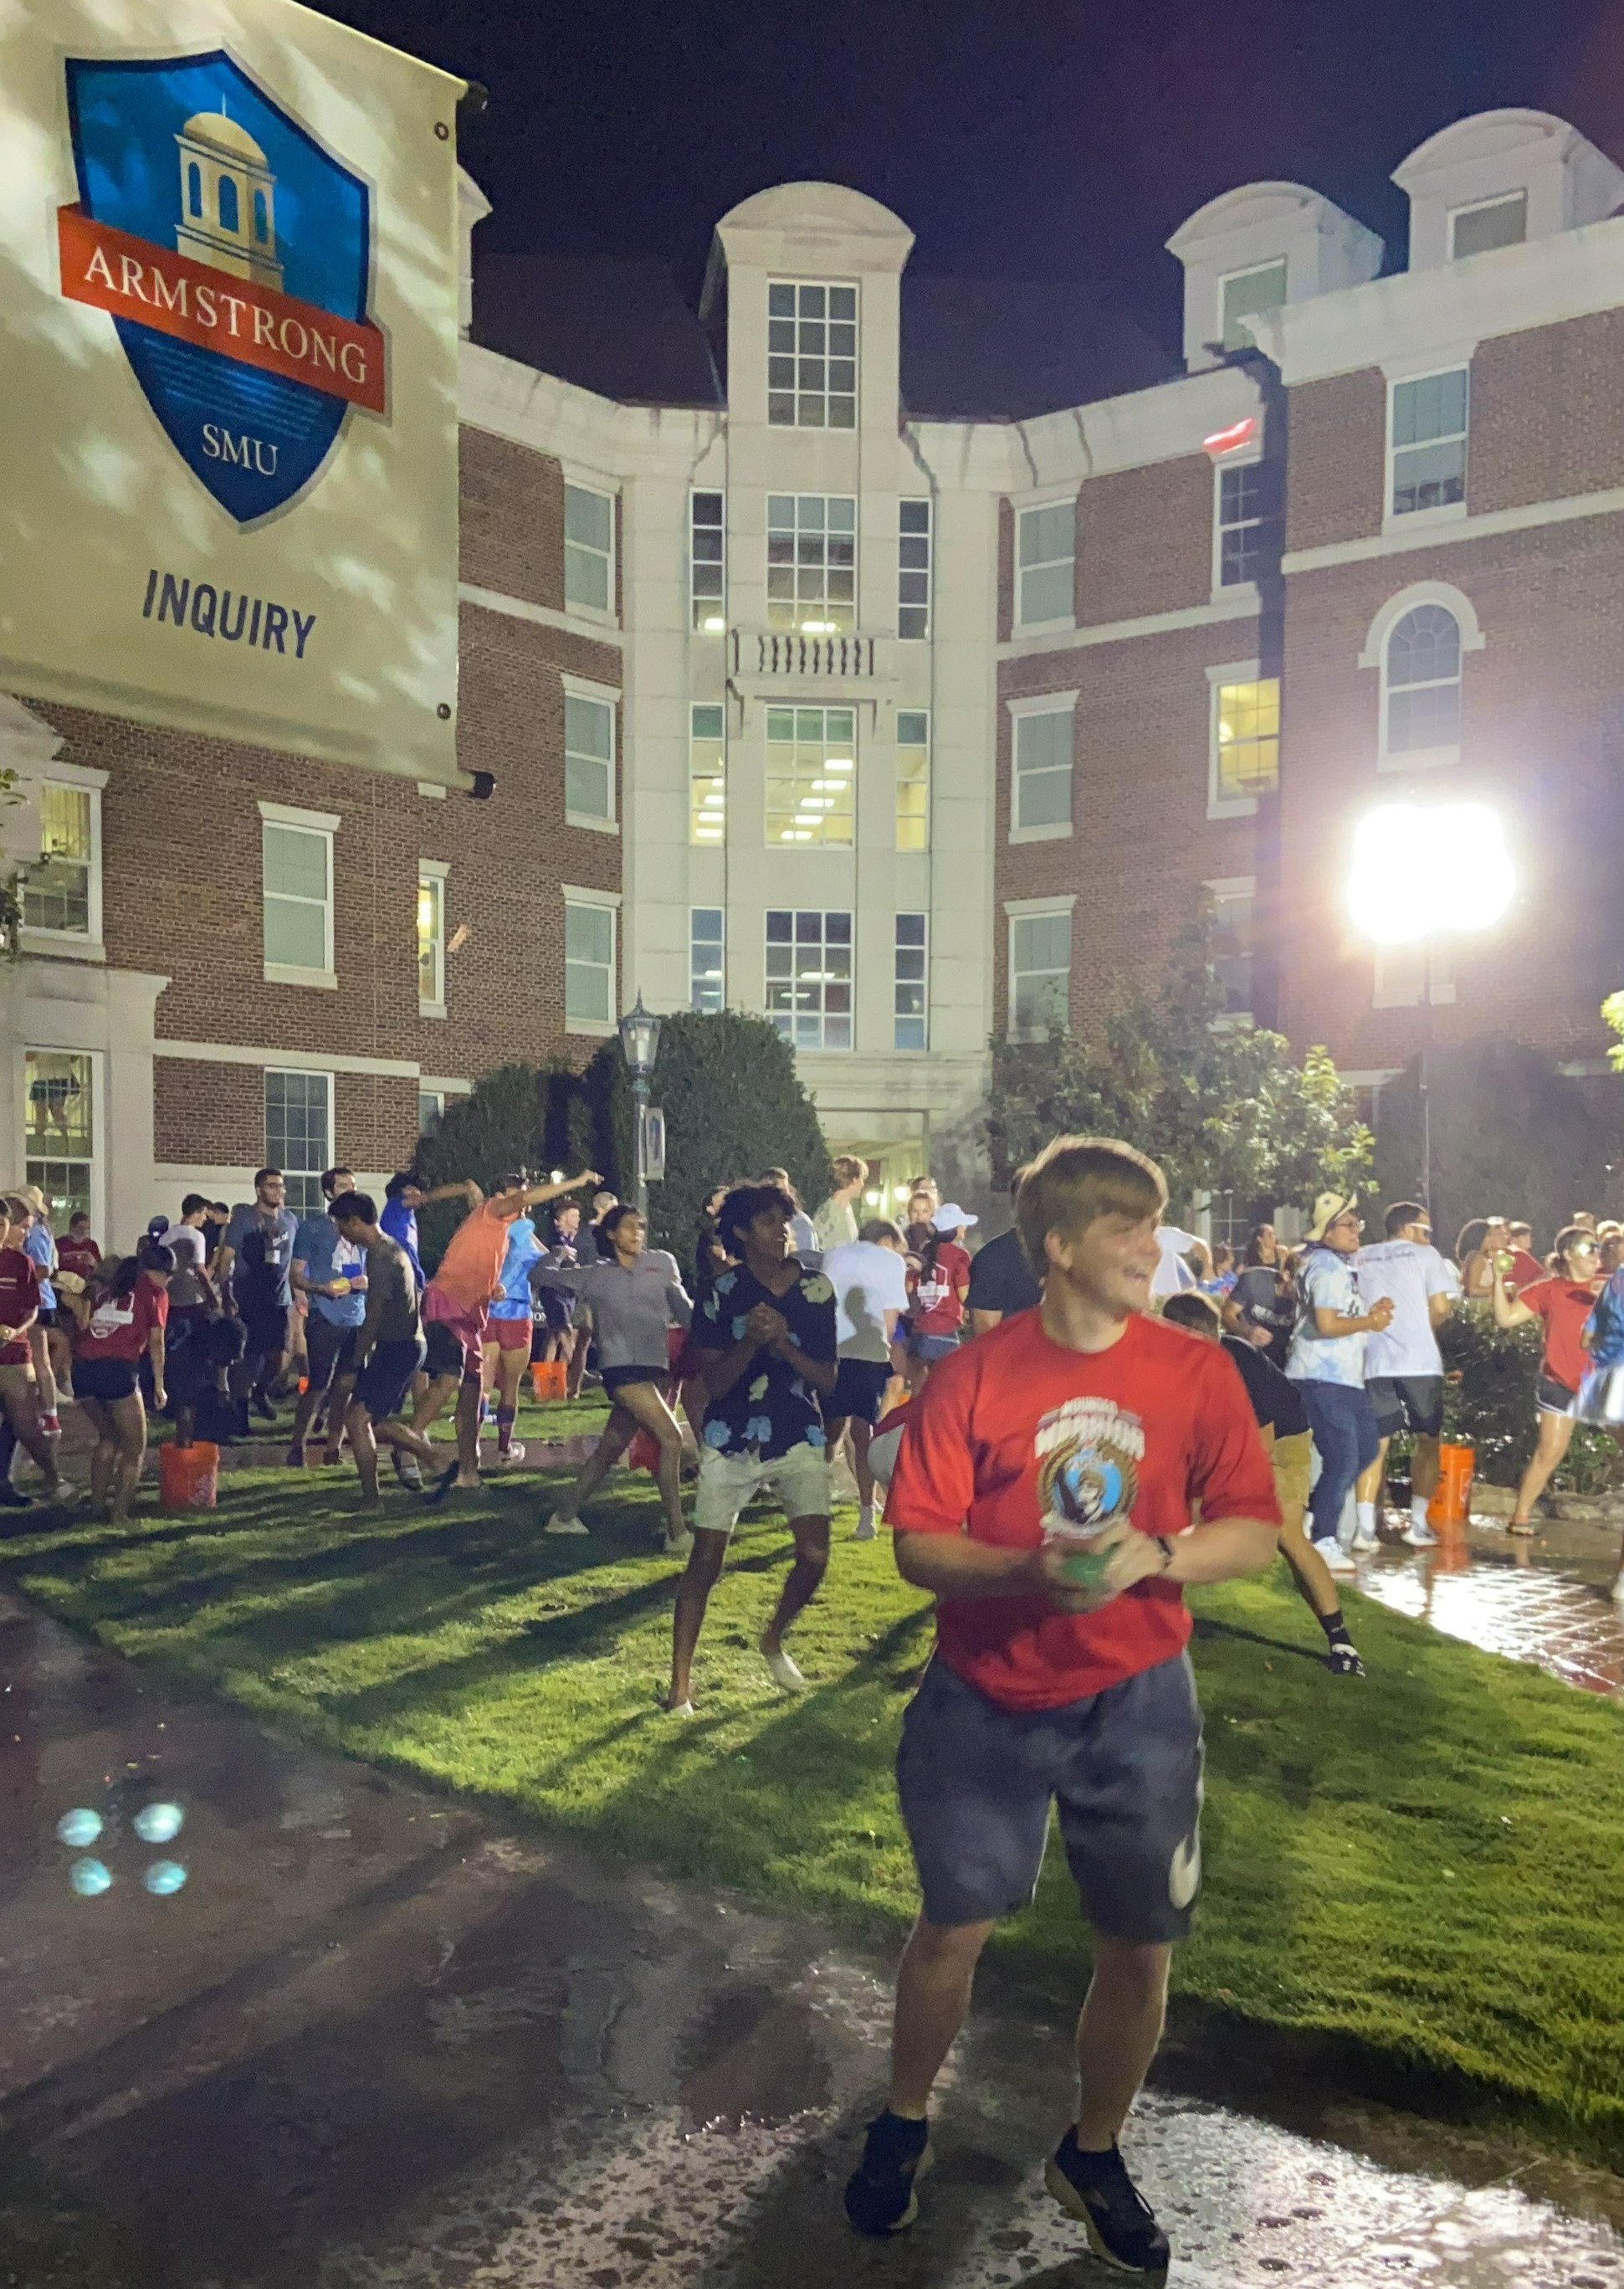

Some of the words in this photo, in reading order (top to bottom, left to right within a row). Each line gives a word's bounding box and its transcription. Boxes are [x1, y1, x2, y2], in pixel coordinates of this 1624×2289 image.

[84, 246, 368, 383] ARMSTRONG
[202, 423, 279, 475] SMU
[142, 568, 316, 659] INQUIRY
